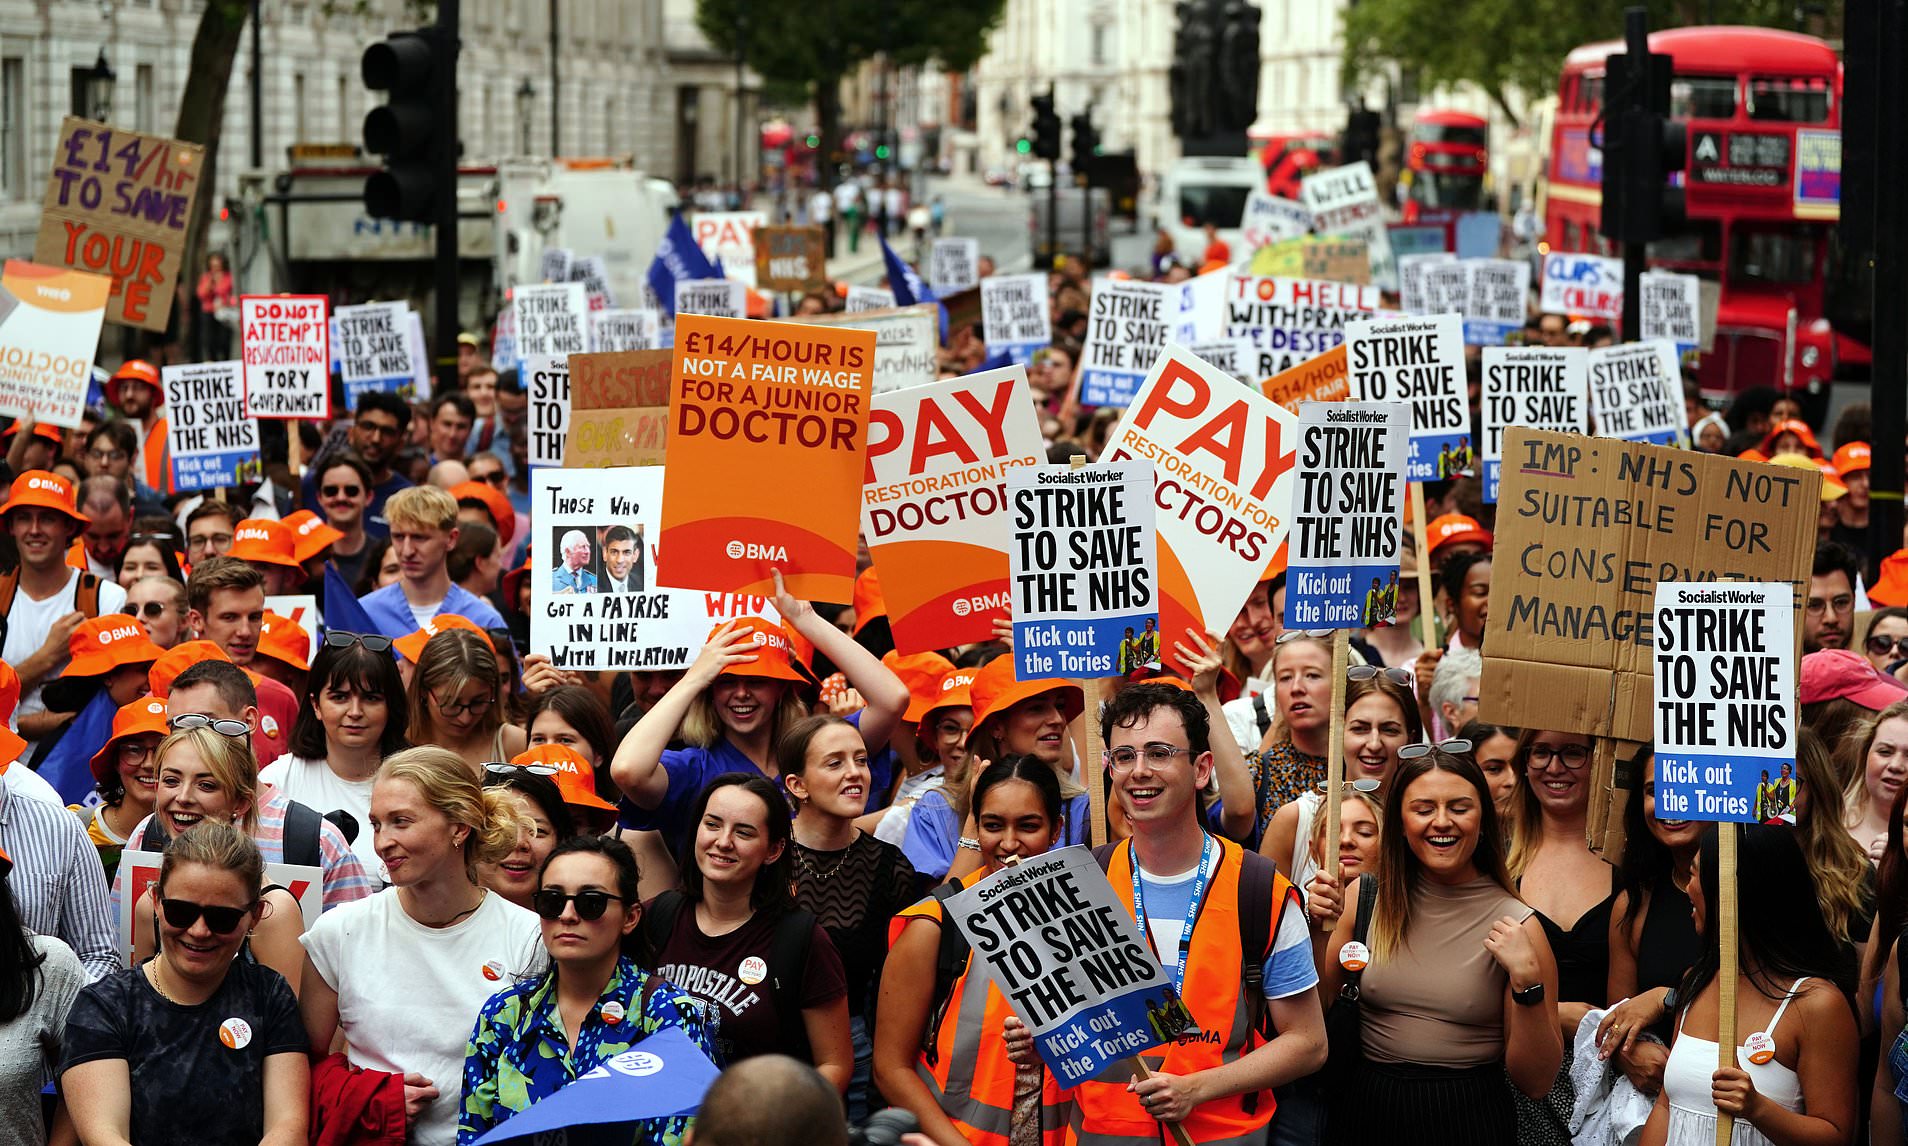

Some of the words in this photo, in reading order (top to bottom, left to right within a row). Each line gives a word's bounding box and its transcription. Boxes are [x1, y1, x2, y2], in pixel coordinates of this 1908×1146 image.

[64, 129, 195, 190] £14/hr
[1695, 133, 1719, 161] A
[54, 168, 102, 209] TO
[111, 182, 188, 231] SAVE
[64, 220, 165, 285] YOUR
[519, 295, 569, 315] STRIKE
[679, 291, 730, 309] STRIKE
[986, 286, 1032, 302] STRIKE
[1096, 293, 1162, 321] STRIKE
[1235, 277, 1276, 302] TO
[1292, 282, 1374, 312] HELL
[255, 304, 282, 319] DO
[285, 304, 319, 319] NOT
[340, 313, 394, 338] STRIKE
[519, 317, 538, 335] TO
[543, 314, 578, 333] SAVE
[1229, 303, 1297, 327] WITH
[247, 322, 323, 342] ATTEMPT
[599, 321, 644, 336] STRIKE
[1094, 318, 1117, 341] TO
[1124, 320, 1170, 346] SAVE
[343, 339, 366, 358] TO
[368, 333, 403, 354] SAVE
[521, 337, 547, 355] THE
[552, 335, 583, 352] NHS
[685, 332, 833, 366] £14/HOUR
[839, 345, 864, 369] IS
[1092, 342, 1124, 367] THE
[1352, 334, 1441, 369] STRIKE
[346, 358, 376, 377] THE
[380, 353, 410, 374] NHS
[682, 357, 728, 377] NOT
[730, 362, 746, 379] A
[751, 364, 798, 384] FAIR
[802, 369, 861, 390] WAGE
[1488, 365, 1567, 393] STRIKE
[1593, 354, 1660, 386] STRIKE
[169, 376, 236, 402] STRIKE
[265, 371, 310, 389] TORY
[1315, 380, 1345, 400] FAIR
[1354, 369, 1387, 402] TO
[1395, 365, 1457, 399] SAVE
[248, 393, 323, 413] GOVERNMENT
[681, 379, 734, 402] FOR
[739, 385, 758, 406] A
[762, 386, 860, 415] JUNIOR
[1487, 396, 1516, 423] TO
[1525, 396, 1577, 424] SAVE
[1597, 386, 1620, 410] TO
[172, 405, 195, 426] TO
[203, 401, 247, 422] SAVE
[532, 401, 562, 430] TO
[678, 403, 858, 451] DOCTOR
[1411, 397, 1463, 430] NHS
[1601, 408, 1638, 435] THE
[172, 427, 210, 451] THE
[216, 423, 253, 447] NHS
[575, 416, 625, 454] OUR
[863, 379, 1015, 485] PAY
[1133, 357, 1298, 502] PAY
[1302, 425, 1387, 470] STRIKE
[203, 457, 222, 470] out
[41, 479, 64, 495] BMA
[180, 475, 196, 488] the
[864, 464, 996, 505] RESTORATION
[1121, 428, 1245, 512] RESTORATION
[1241, 504, 1280, 534] FOR
[1300, 471, 1332, 514] TO
[1339, 471, 1398, 514] SAVE
[1617, 452, 1698, 497] NHS
[1725, 468, 1800, 508] NOT
[547, 486, 594, 515] THOSE
[610, 496, 640, 515] WHO
[1014, 485, 1126, 530] STRIKE
[244, 527, 270, 541] BMA
[1517, 489, 1675, 534] SUITABLE
[1704, 513, 1772, 554] FOR
[1014, 530, 1057, 571] TO
[1069, 525, 1144, 571] SAVE
[1297, 517, 1343, 559] THE
[1350, 516, 1398, 559] NHS
[746, 543, 788, 562] BMA
[1016, 573, 1078, 614] THE
[1089, 567, 1151, 613] NHS
[1297, 573, 1328, 595] Kick
[1329, 573, 1351, 594] out
[547, 601, 574, 618] GOT
[583, 601, 594, 618] A
[971, 591, 1012, 612] BMA
[1295, 601, 1321, 622] the
[1324, 600, 1359, 622] Tories
[111, 625, 141, 641] BMA
[568, 624, 593, 642] IN
[600, 622, 638, 642] LINE
[1024, 625, 1061, 648] Kick
[1066, 626, 1096, 647] out
[1658, 607, 1766, 653] STRIKE
[550, 645, 595, 667] WITH
[607, 647, 689, 667] INFLATION
[1024, 652, 1053, 674] the
[1058, 650, 1112, 672] Tories
[1657, 654, 1697, 699] TO
[1710, 654, 1781, 701] SAVE
[1658, 701, 1717, 747] THE
[1727, 703, 1787, 750] NHS
[1662, 759, 1699, 784] Kick
[1704, 765, 1733, 786] out
[1662, 788, 1689, 813] the
[1695, 789, 1749, 815] Tories
[966, 872, 1091, 952] STRIKE
[1135, 891, 1143, 909] NHS
[1137, 912, 1145, 931] NHS
[1177, 959, 1186, 977] NHS
[1188, 901, 1198, 919] NHS
[1193, 880, 1203, 897] NHS
[1199, 859, 1209, 876] NHS
[986, 941, 1043, 991] TO
[1040, 905, 1132, 964] SAVE
[744, 959, 765, 971] PAY
[1011, 965, 1087, 1029] THE
[1080, 943, 1156, 996] NHS
[1045, 1023, 1089, 1058] Kick
[1089, 1008, 1122, 1034] out
[1751, 1035, 1763, 1043] PAY
[1752, 1043, 1766, 1051] NOW
[1060, 1056, 1095, 1081] the
[1090, 1027, 1149, 1062] Tories
